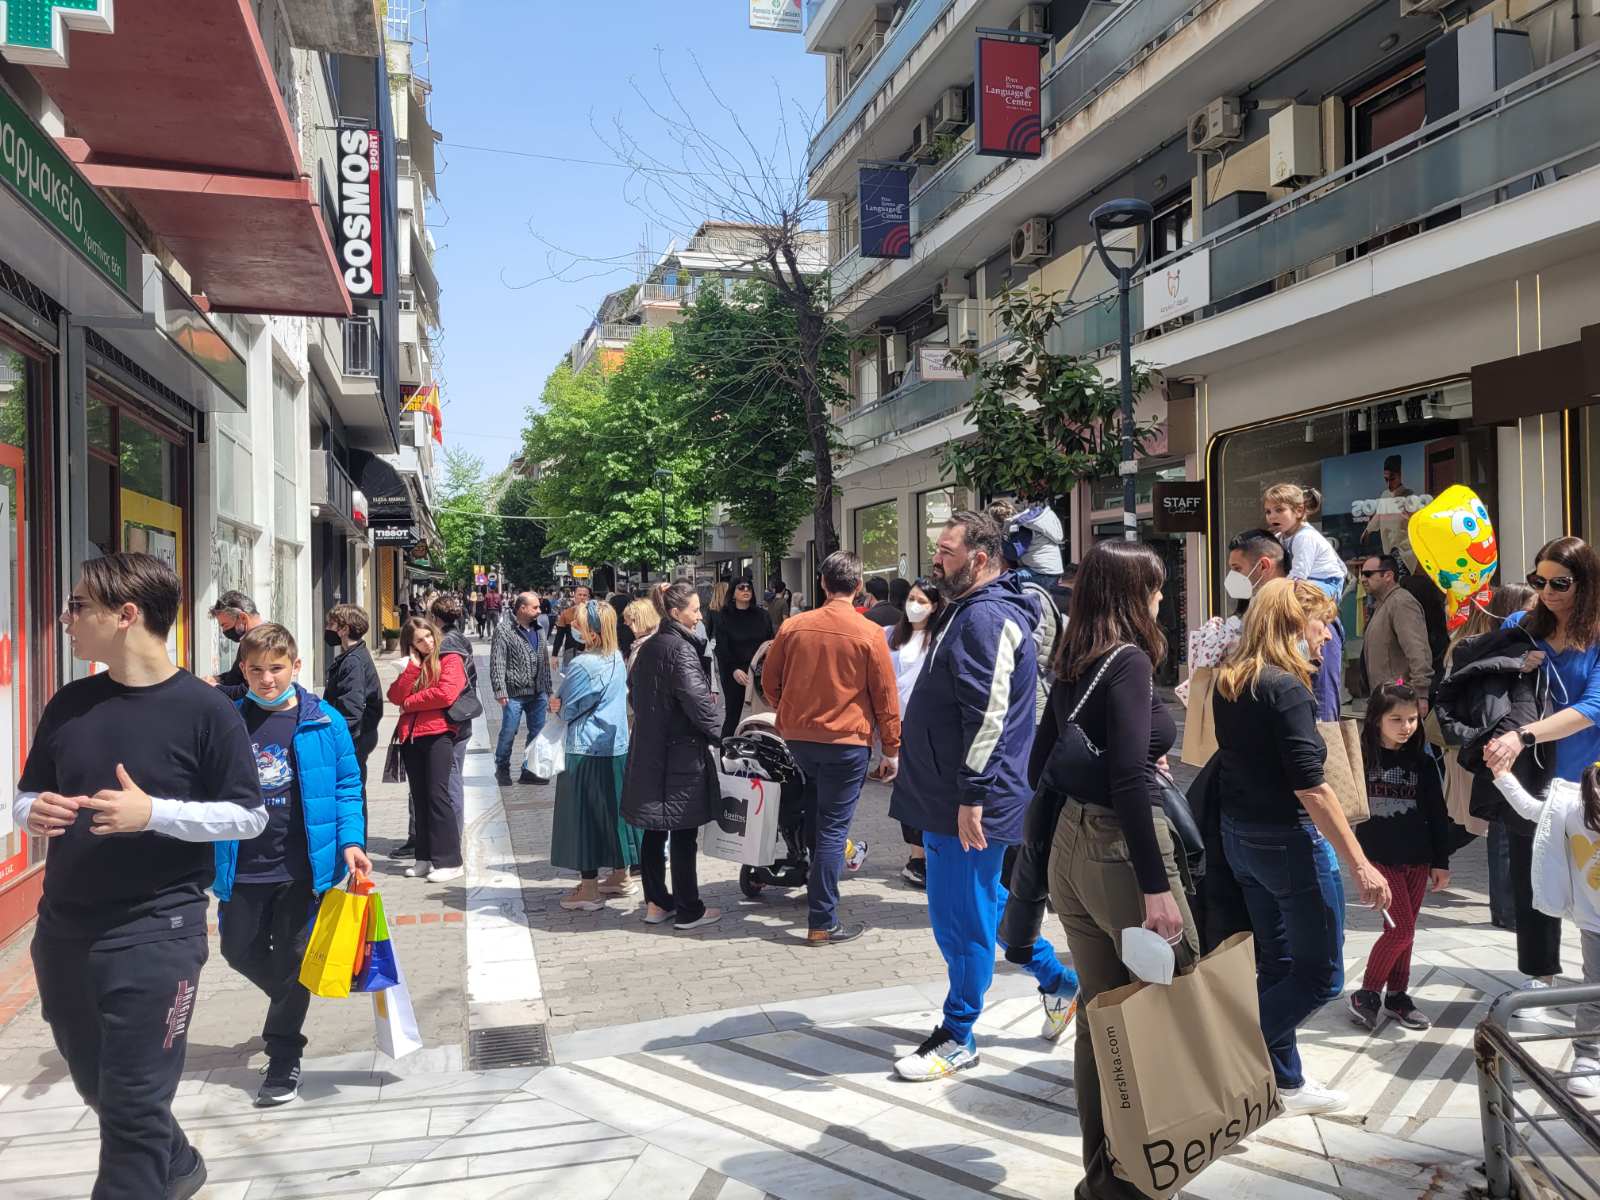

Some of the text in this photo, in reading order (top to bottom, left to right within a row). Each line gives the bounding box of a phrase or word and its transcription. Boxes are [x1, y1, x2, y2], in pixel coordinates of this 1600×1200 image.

[985, 84, 1023, 98] Language
[1005, 96, 1032, 107] Center
[369, 135, 380, 171] SPORT
[0, 119, 83, 233] αρμακείο
[341, 129, 373, 294] COSMOS
[1163, 497, 1201, 508] STAFF
[375, 529, 409, 537] TISSOT
[1104, 1025, 1131, 1109] bershka.com
[1142, 1081, 1284, 1191] Bershk
